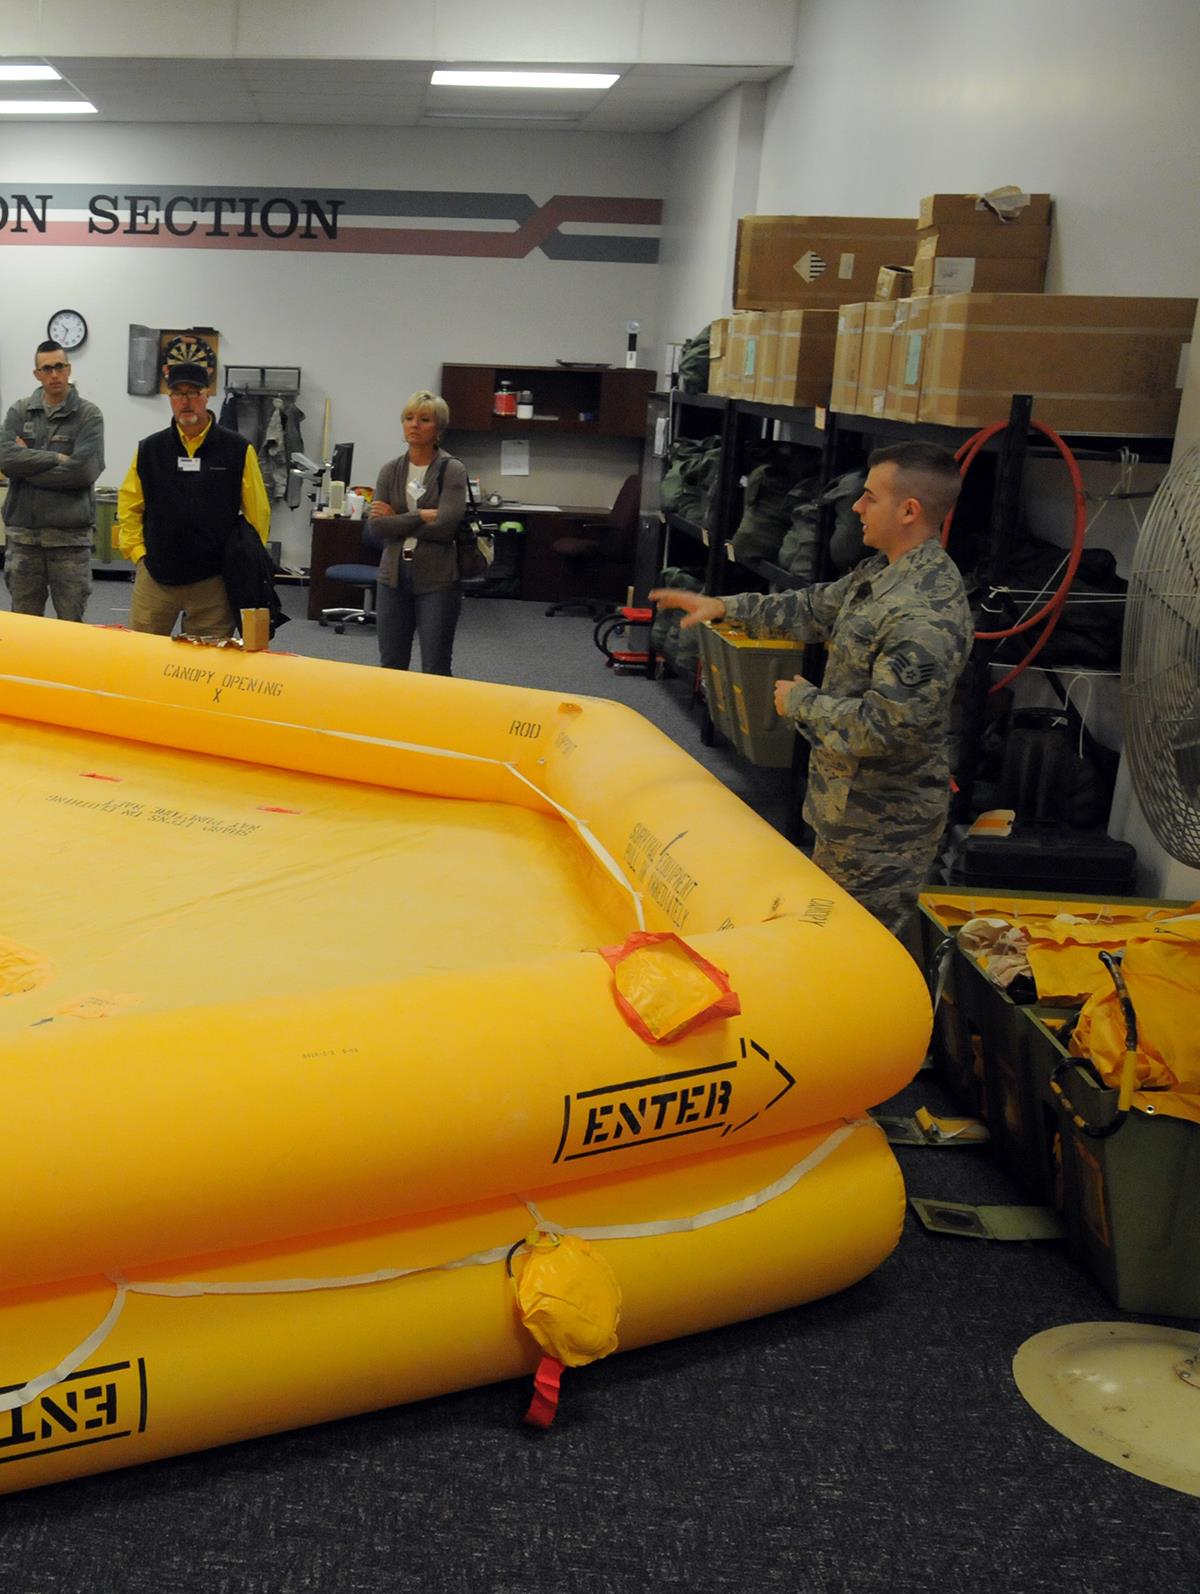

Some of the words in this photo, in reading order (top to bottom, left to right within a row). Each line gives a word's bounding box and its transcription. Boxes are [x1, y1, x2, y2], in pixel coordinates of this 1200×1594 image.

[88, 195, 345, 240] SECTION
[163, 663, 216, 684] CANOPY
[221, 673, 284, 697] OPENING
[212, 687, 223, 703] X
[508, 719, 542, 740] ROD
[797, 897, 835, 928] CANOPY
[582, 1080, 733, 1146] ENTER
